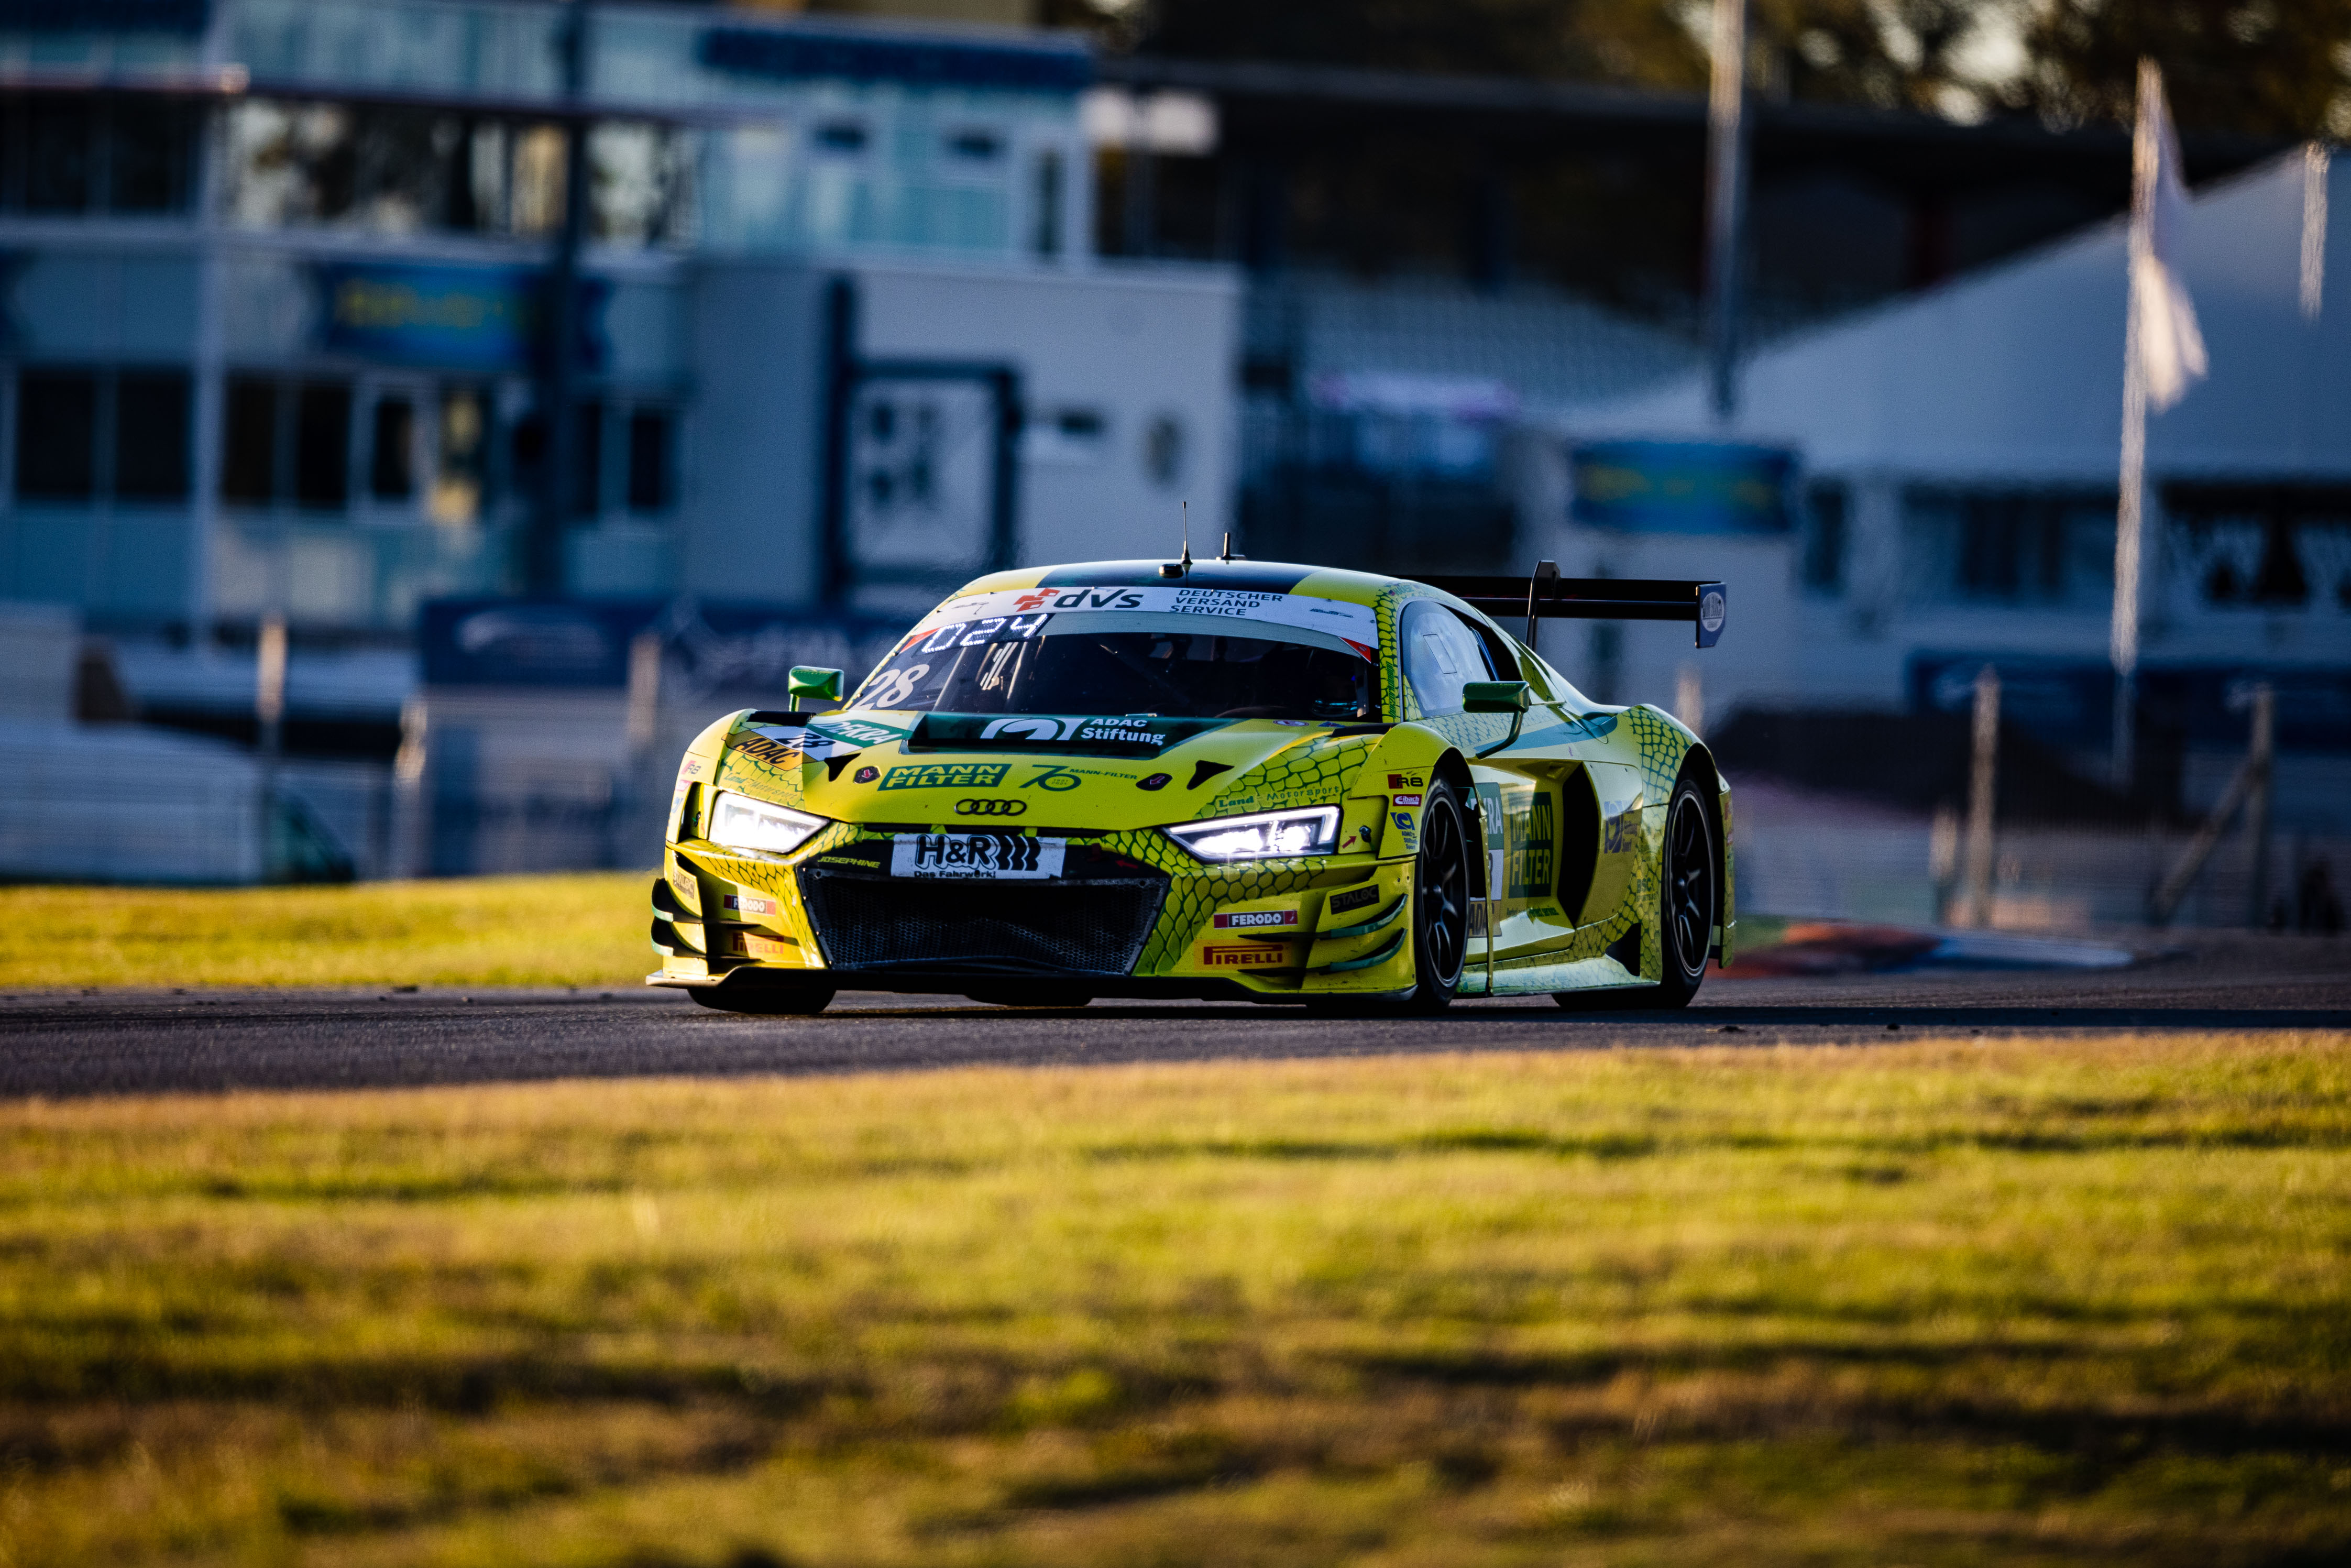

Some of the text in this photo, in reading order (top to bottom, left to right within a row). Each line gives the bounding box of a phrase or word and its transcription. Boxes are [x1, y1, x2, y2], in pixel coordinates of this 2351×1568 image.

[1053, 589, 1145, 609] dvs
[1176, 597, 1260, 608] VERSAND
[1178, 589, 1283, 602] DEUTSCHER
[1169, 605, 1247, 616] SERVICE
[921, 613, 1048, 653] 024
[853, 664, 930, 710] 28
[1090, 717, 1147, 727] ADAC
[774, 732, 836, 749] 28
[815, 721, 903, 744] DEKRA
[1081, 727, 1166, 745] Stiftung
[734, 737, 798, 765] ADAC
[723, 772, 749, 784] Land
[892, 765, 1003, 777] MANN
[1069, 768, 1138, 780] MANN-FILTER
[886, 774, 995, 787] FILTER
[1396, 777, 1424, 787] R8
[1218, 785, 1339, 808] Land Motorsport
[1394, 795, 1420, 805] Eibach
[1511, 805, 1551, 841] MANN
[916, 835, 996, 869] H&R
[817, 856, 881, 869] JOSEPHINE
[1511, 849, 1551, 885] FILTER
[733, 896, 765, 912] FERODO
[1232, 913, 1282, 926] FERODO
[733, 933, 784, 954] PIRELLI
[1203, 945, 1283, 966] PIRELLI
